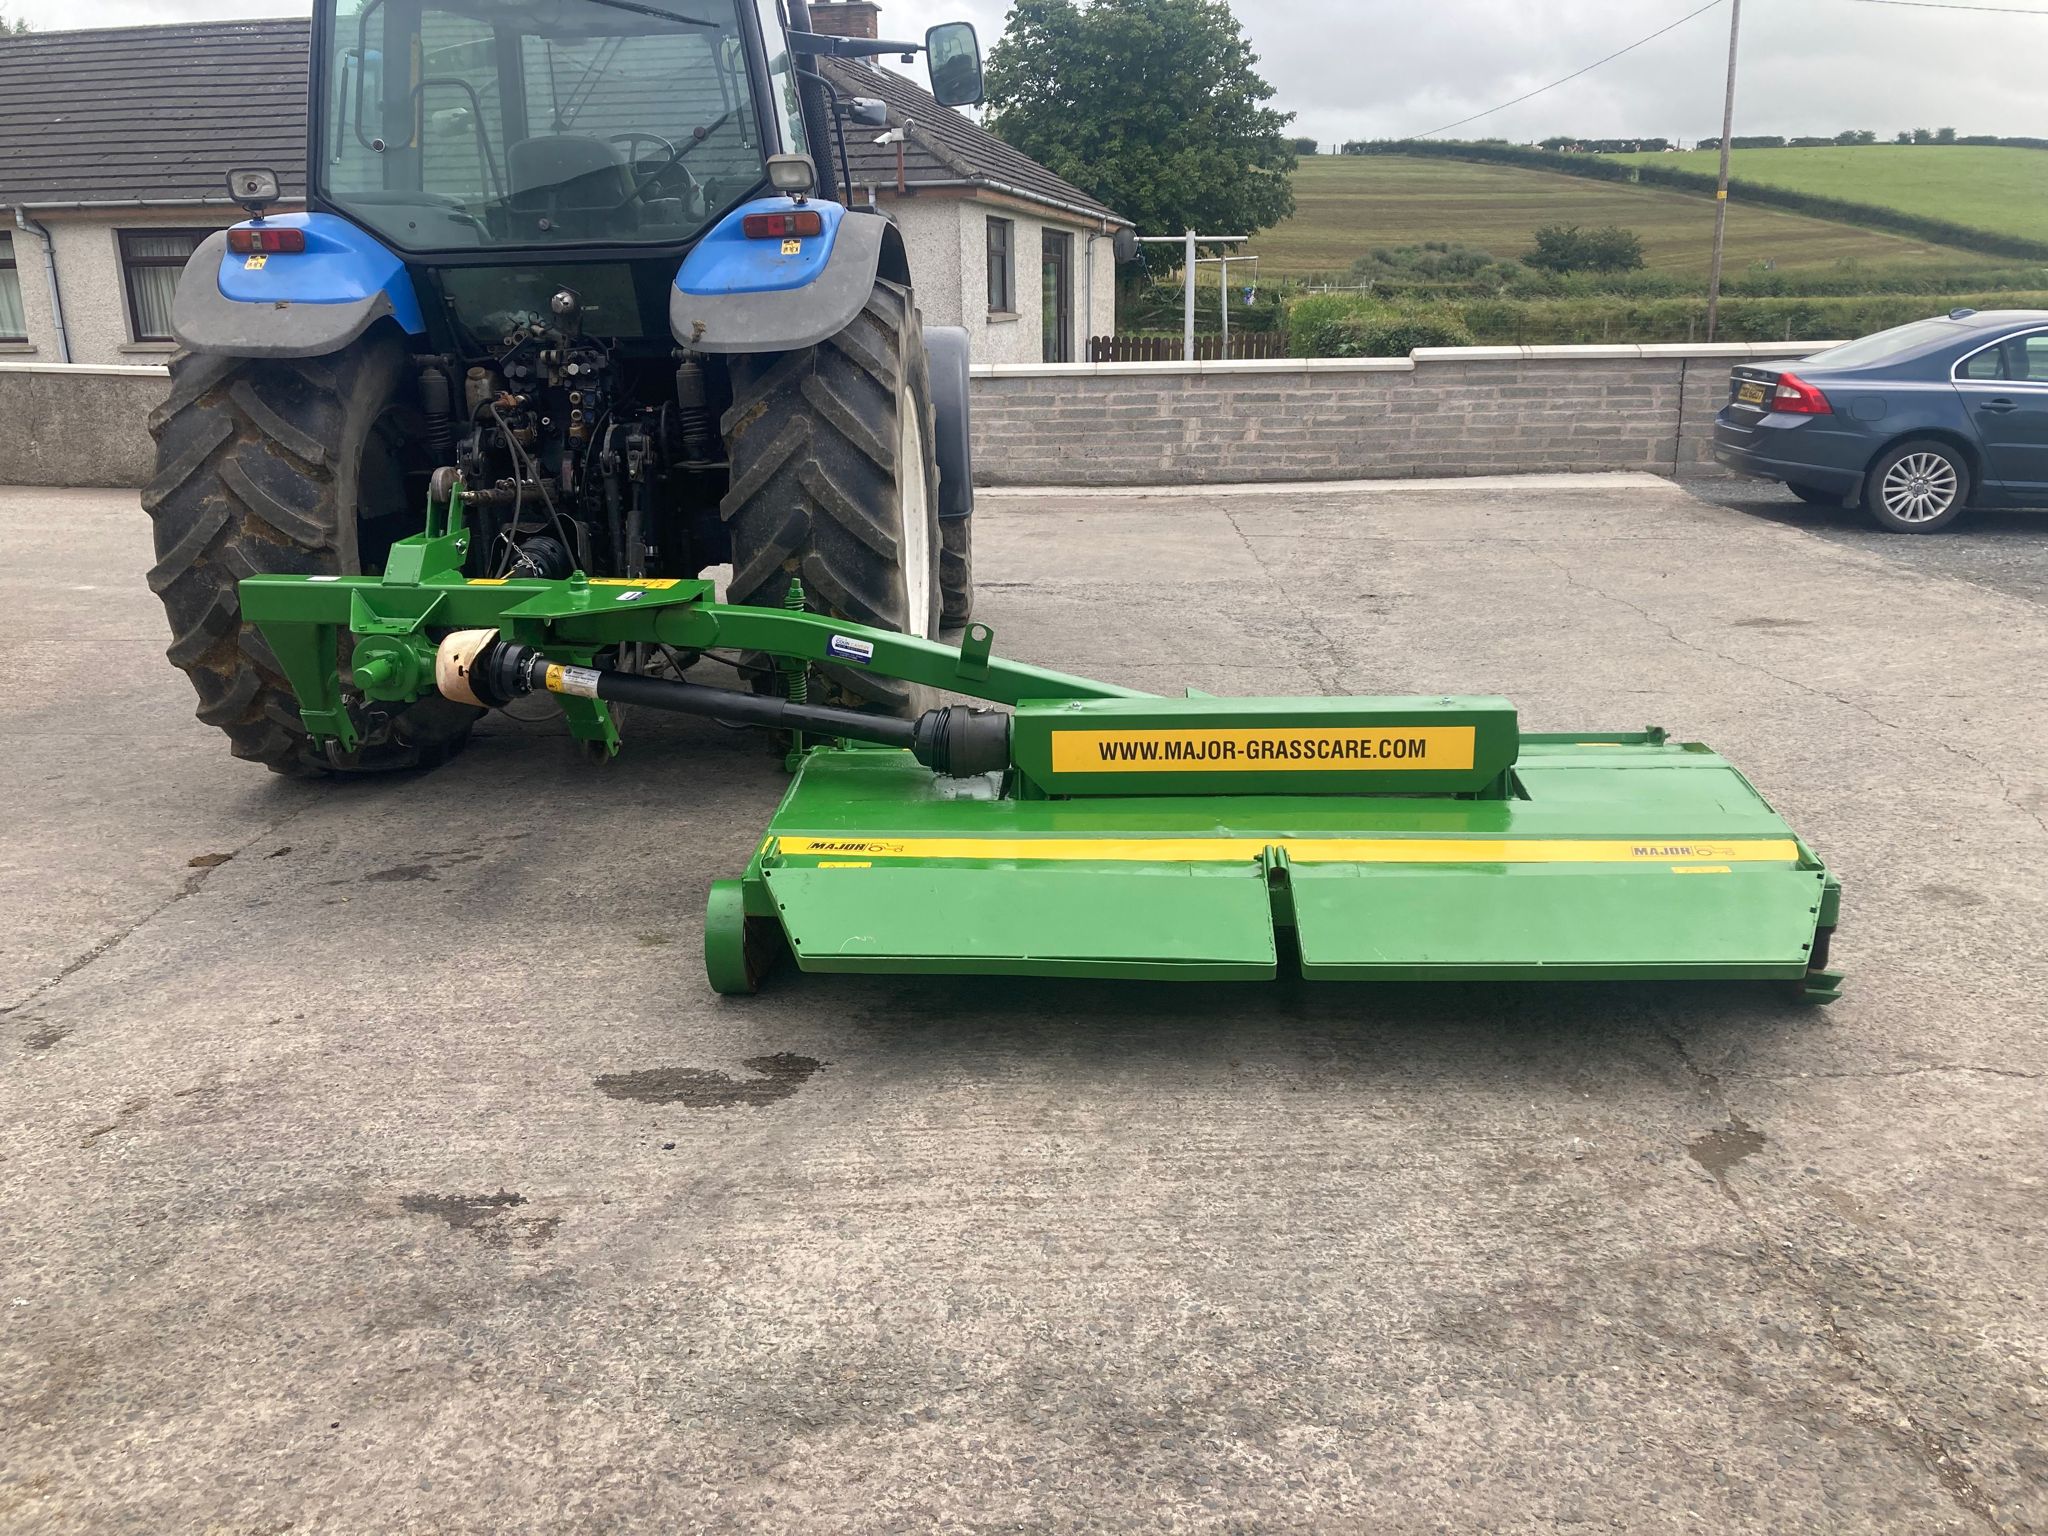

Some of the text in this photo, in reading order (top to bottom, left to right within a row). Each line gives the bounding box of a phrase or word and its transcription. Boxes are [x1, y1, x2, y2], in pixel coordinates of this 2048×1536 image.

[1098, 738, 1427, 761] WWW.MAJOR-GRASSCARE.COM
[810, 842, 866, 851] MAJOR
[1634, 846, 1692, 856] MAJOR
